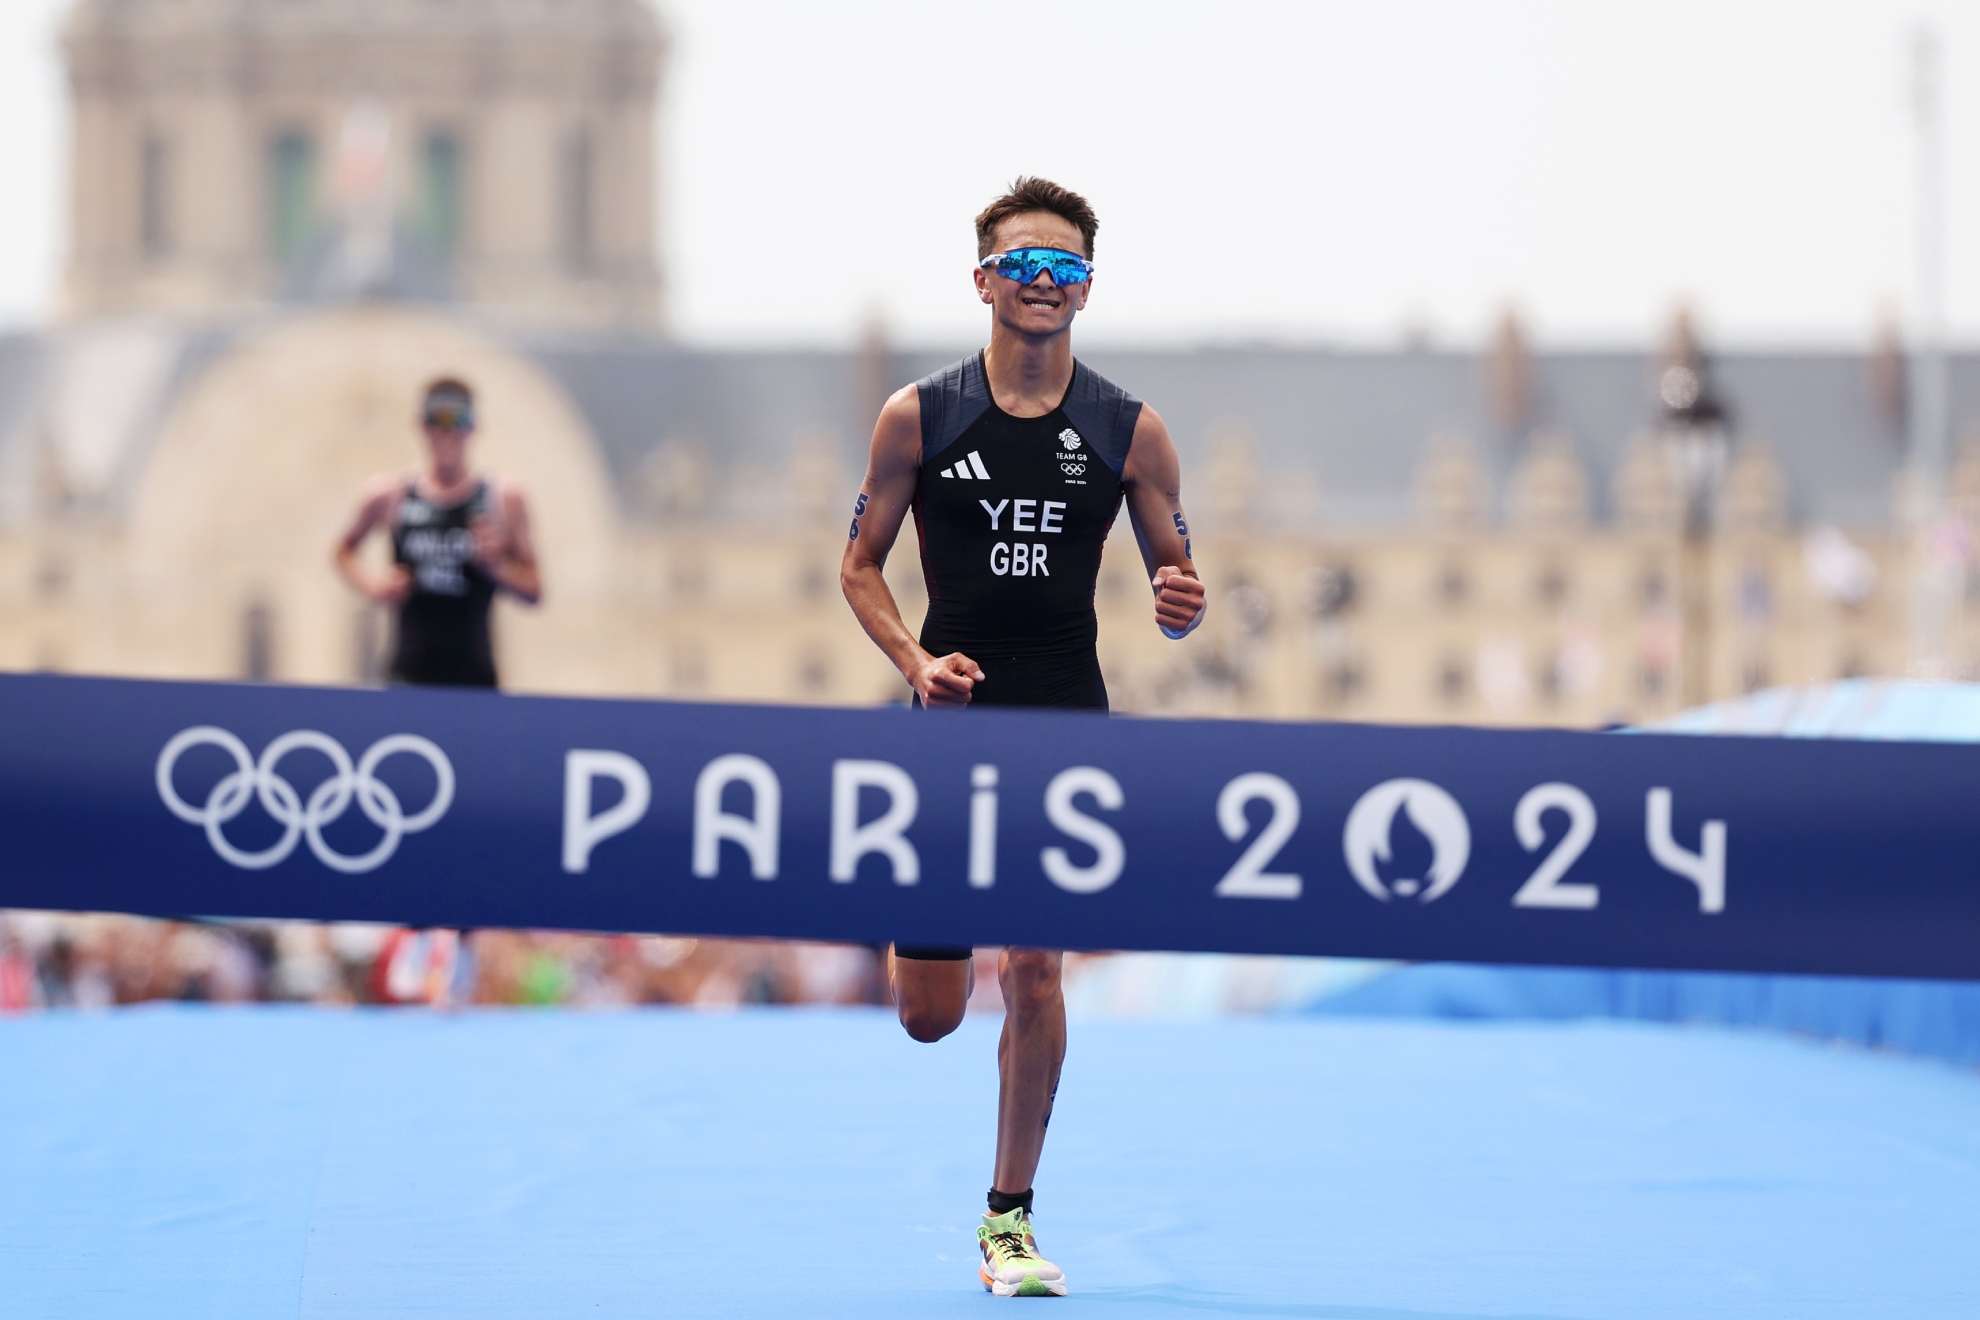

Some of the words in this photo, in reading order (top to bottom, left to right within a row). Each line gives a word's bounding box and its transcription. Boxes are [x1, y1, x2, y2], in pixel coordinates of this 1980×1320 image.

[1055, 452, 1076, 460] TEAM
[1077, 453, 1088, 461] GB
[979, 499, 1067, 533] YEE
[990, 542, 1050, 577] GBR
[1213, 771, 1727, 914] 2024
